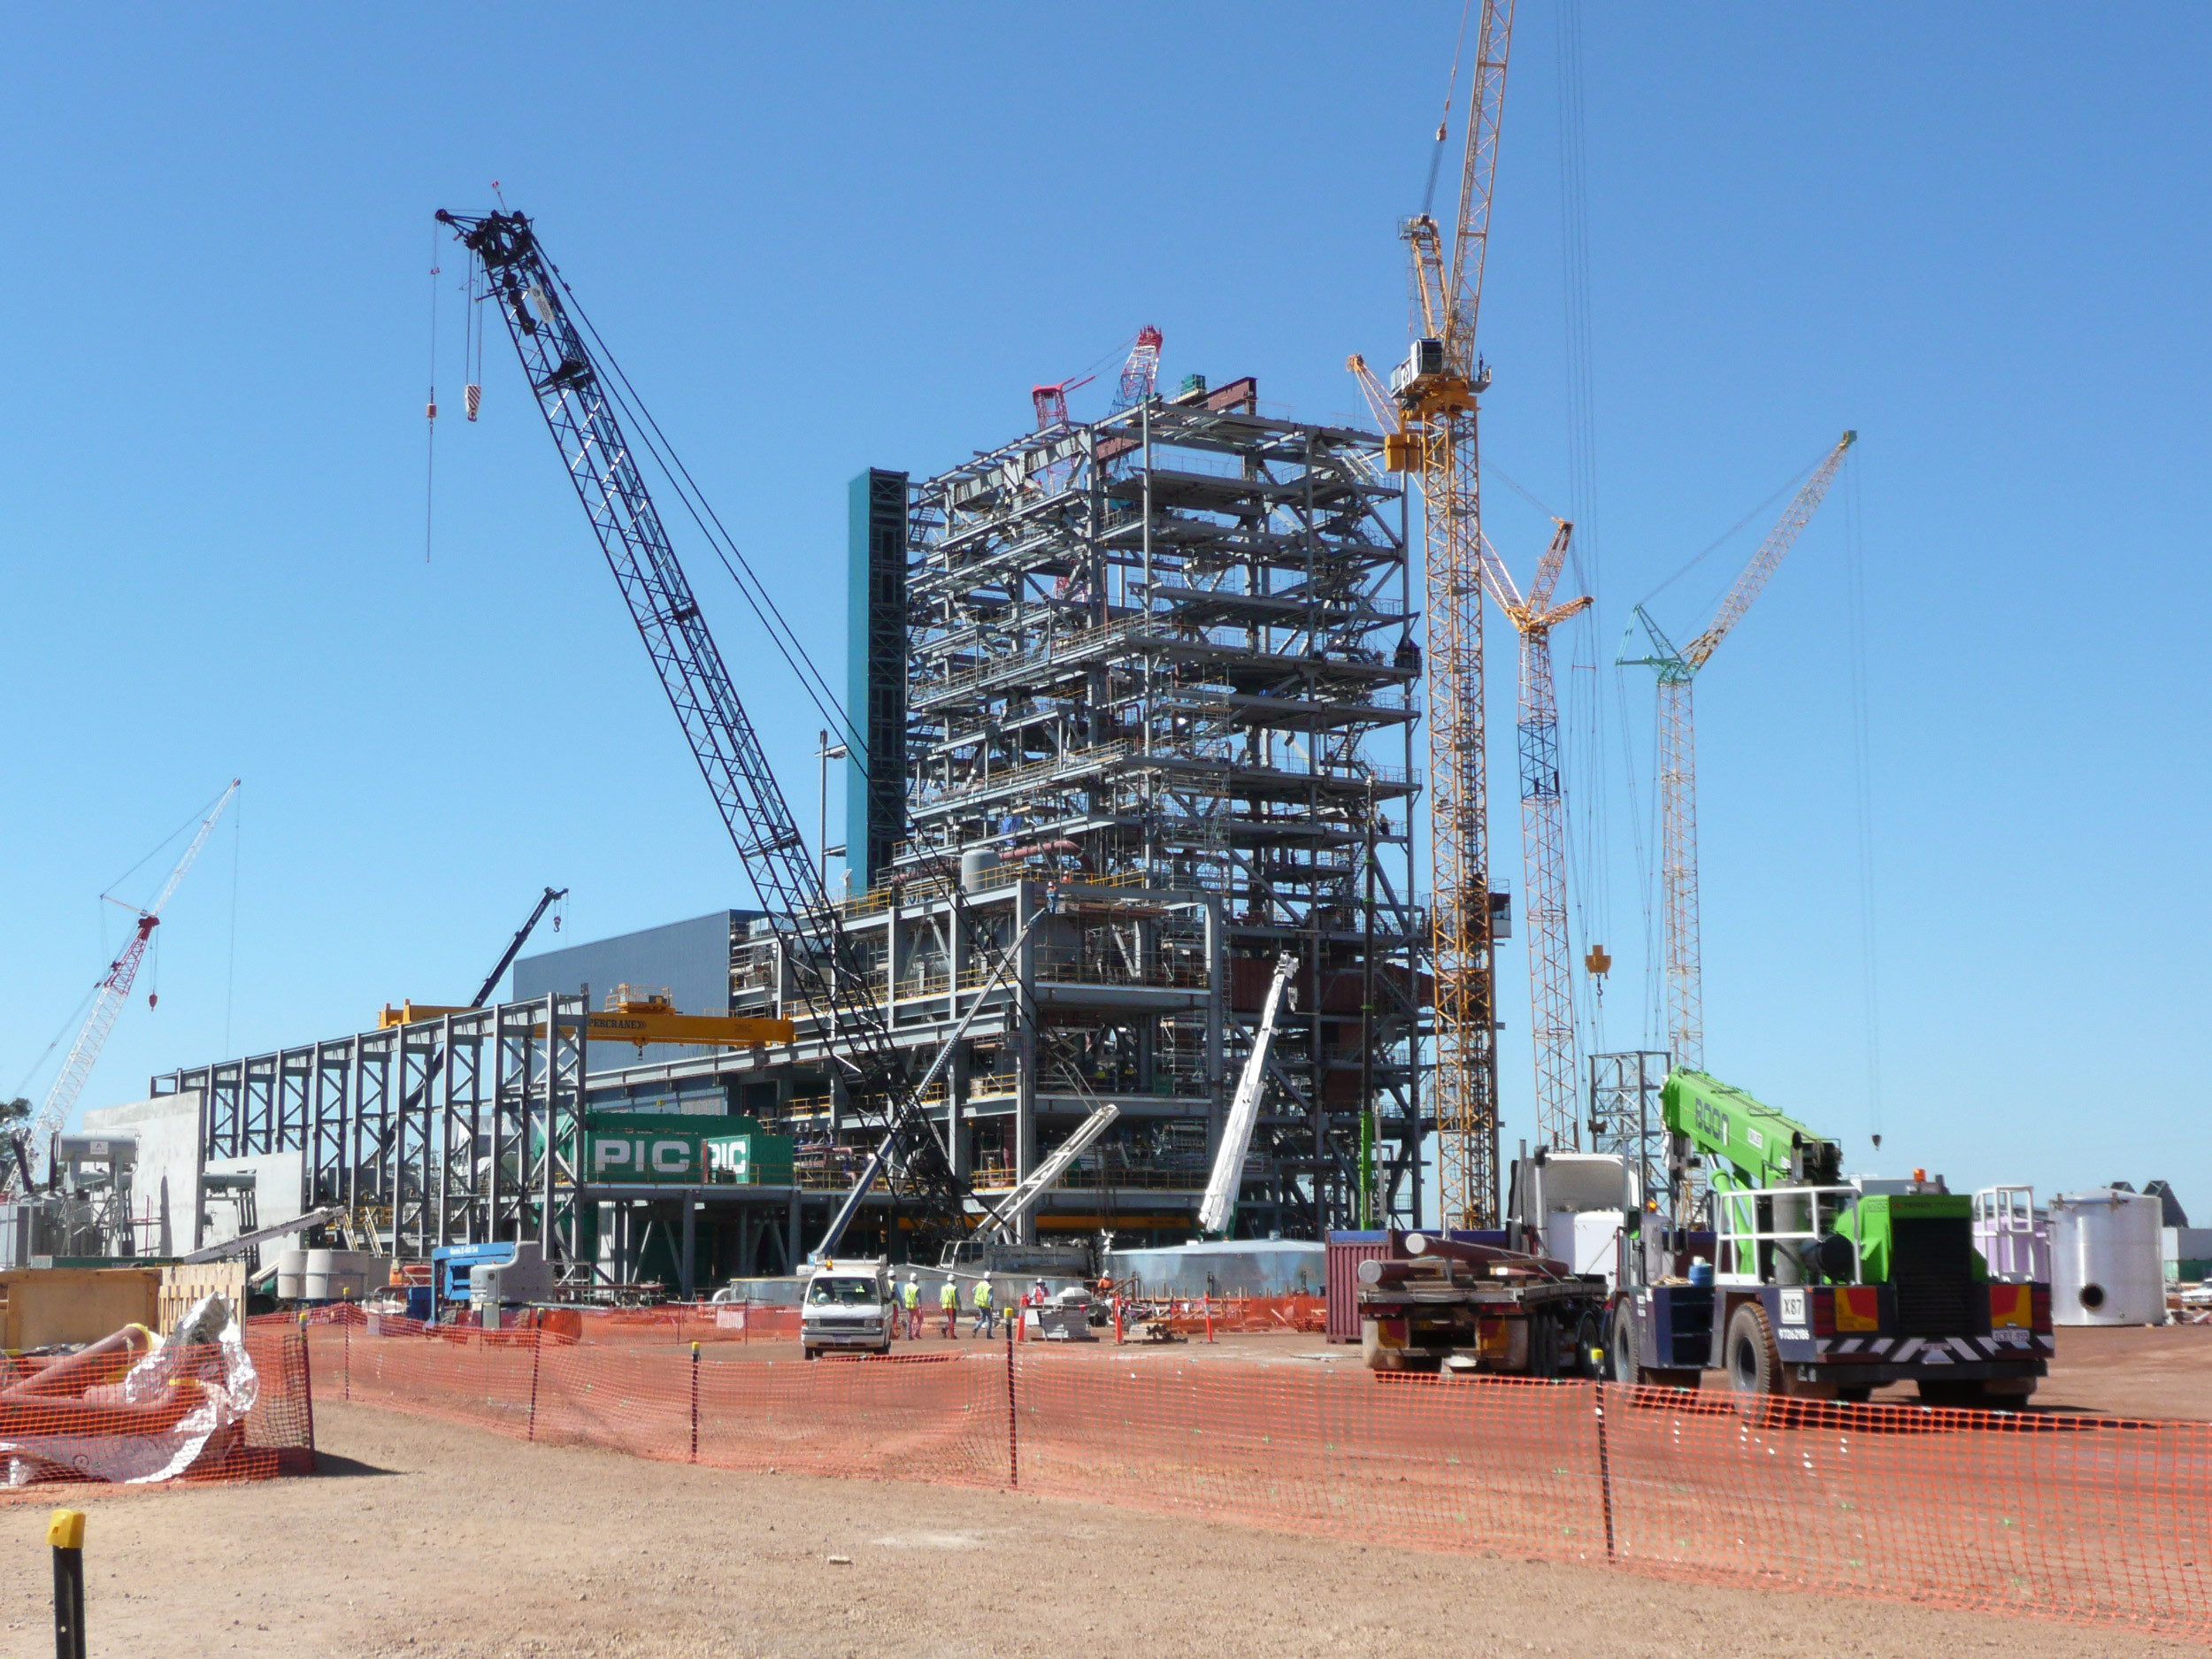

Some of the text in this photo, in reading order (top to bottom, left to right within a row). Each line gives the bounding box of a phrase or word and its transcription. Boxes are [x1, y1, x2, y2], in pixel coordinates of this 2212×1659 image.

[595, 1140, 690, 1172] PIC
[209, 1215, 315, 1253] PACIFIC INDUSTRIAL COMPANY
[1784, 1299, 1802, 1316] X87
